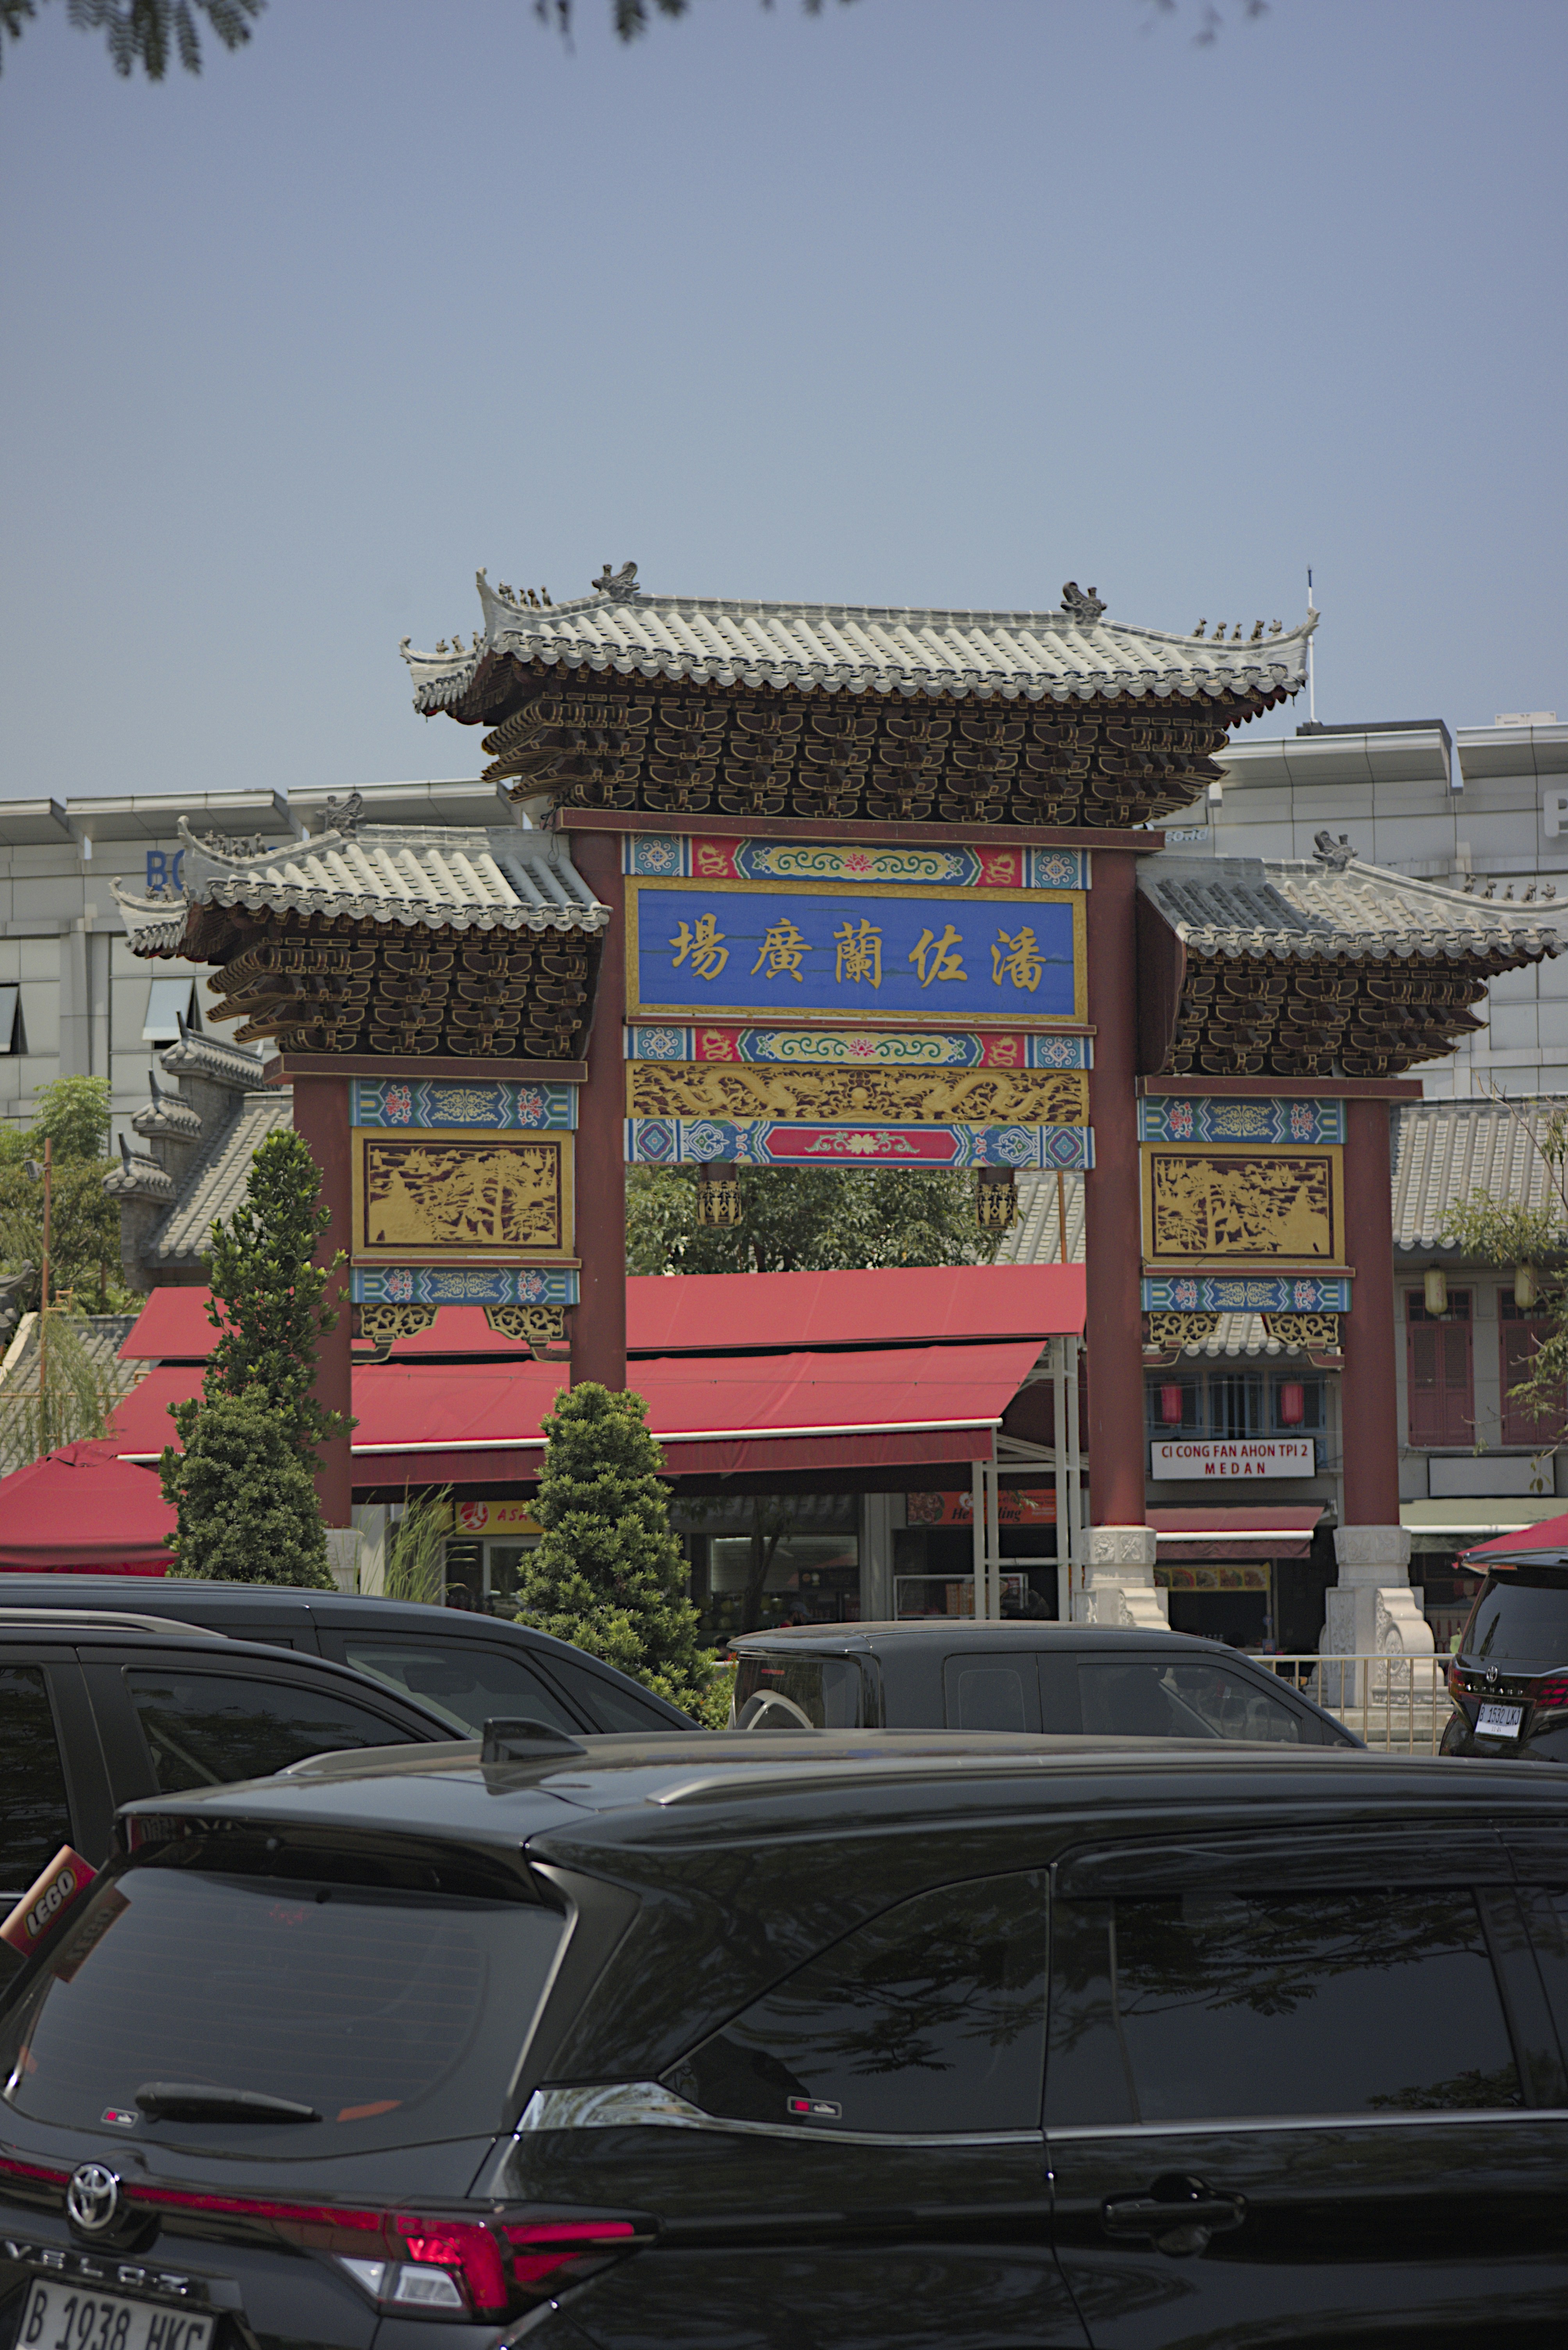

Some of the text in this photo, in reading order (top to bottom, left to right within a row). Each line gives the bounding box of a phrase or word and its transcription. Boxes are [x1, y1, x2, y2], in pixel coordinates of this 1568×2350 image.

[1161, 1444, 1308, 1457] CI CONG FAN AHON TPI 2
[1205, 1462, 1266, 1475] MEDAN
[1479, 1706, 1521, 1725] B 1532 LKJ
[26, 1870, 75, 1936] LEGO
[5, 2240, 189, 2295] VELOZ
[26, 2289, 47, 2343] B
[55, 2295, 131, 2350] 1938
